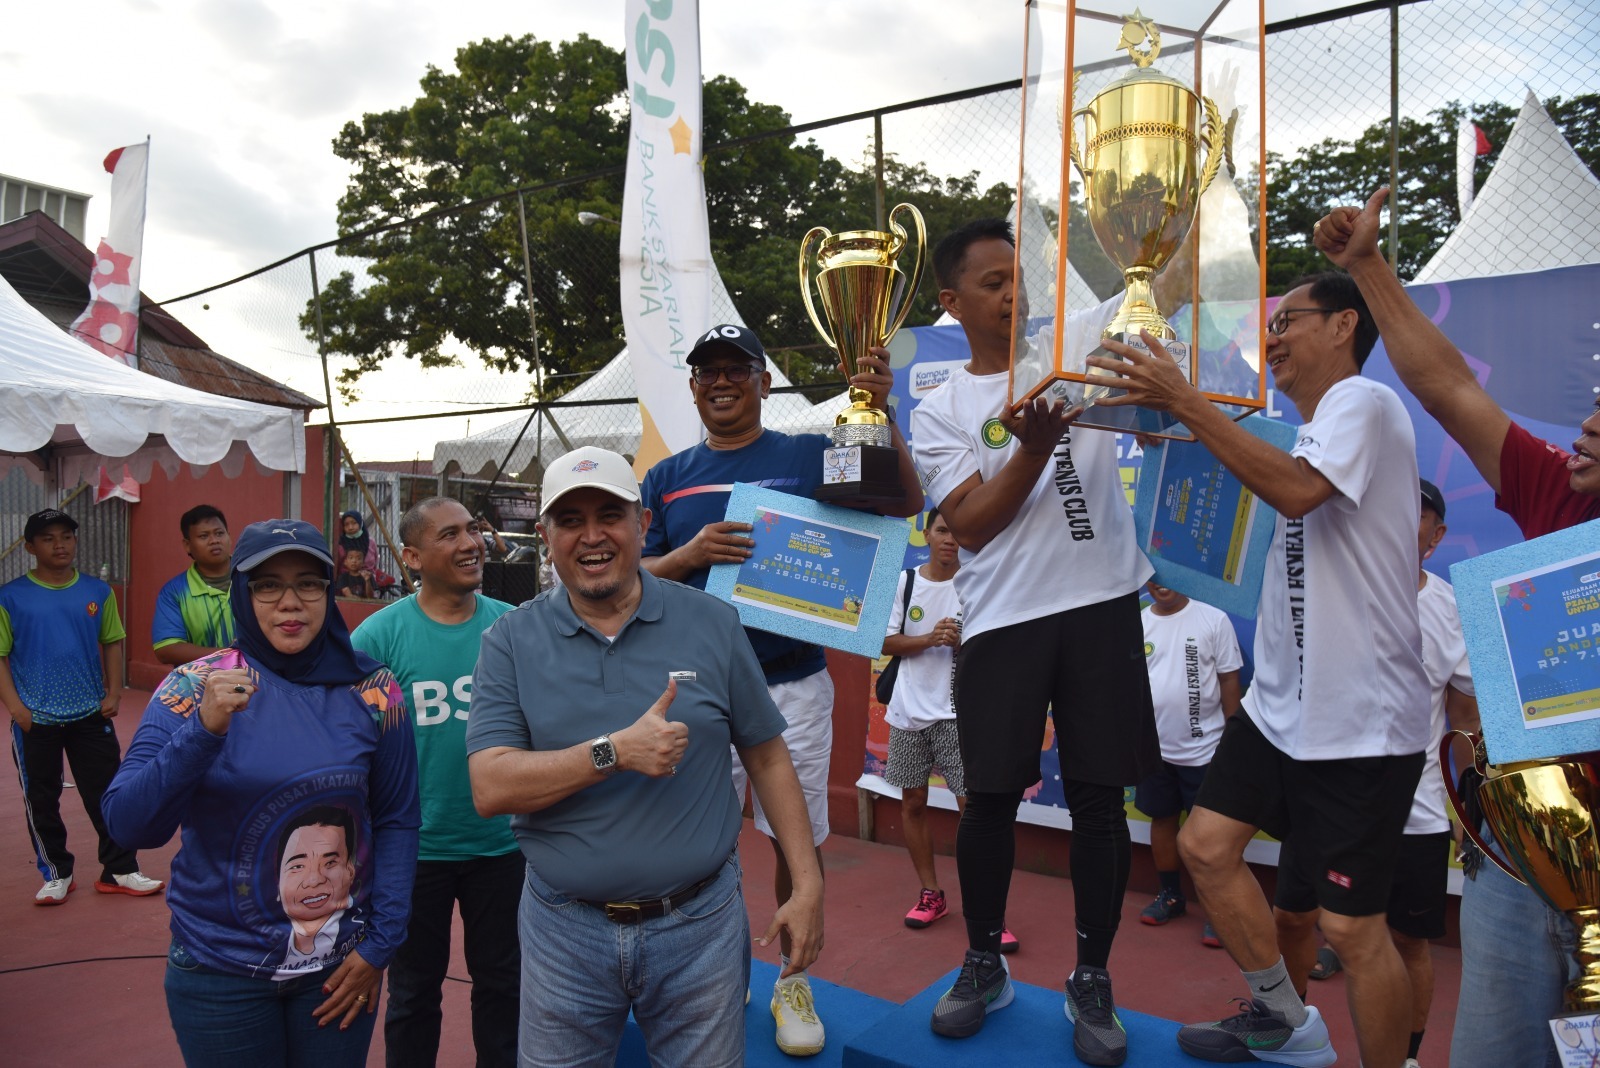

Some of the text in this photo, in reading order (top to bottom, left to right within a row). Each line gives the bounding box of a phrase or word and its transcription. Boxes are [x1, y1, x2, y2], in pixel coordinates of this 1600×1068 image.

[641, 140, 662, 232] BANK
[651, 238, 687, 371] SYARIAH
[704, 325, 741, 342] AO
[916, 368, 950, 382] Kampus
[1053, 448, 1083, 495] TENIS
[1190, 487, 1208, 538] JUARA
[1202, 471, 1210, 479] 1
[1063, 498, 1095, 541] CLUB
[1286, 516, 1305, 589] HYAKSA
[752, 562, 771, 573] RP.
[763, 559, 801, 574] GANDA
[774, 553, 823, 572] JUARA
[831, 567, 841, 576] 2
[1562, 583, 1598, 597] KEJUARAAN
[1563, 593, 1581, 602] TENIS
[1565, 594, 1597, 608] PIALA
[1567, 601, 1600, 616] UNTAD
[1537, 654, 1568, 670] RP.
[1185, 644, 1203, 738] ADHYAKSA TENIS CLUB
[238, 812, 272, 878] PENGURUS
[267, 783, 308, 815] PUSAT
[312, 773, 359, 791] IKATAN
[1564, 1021, 1590, 1031] JUARA
